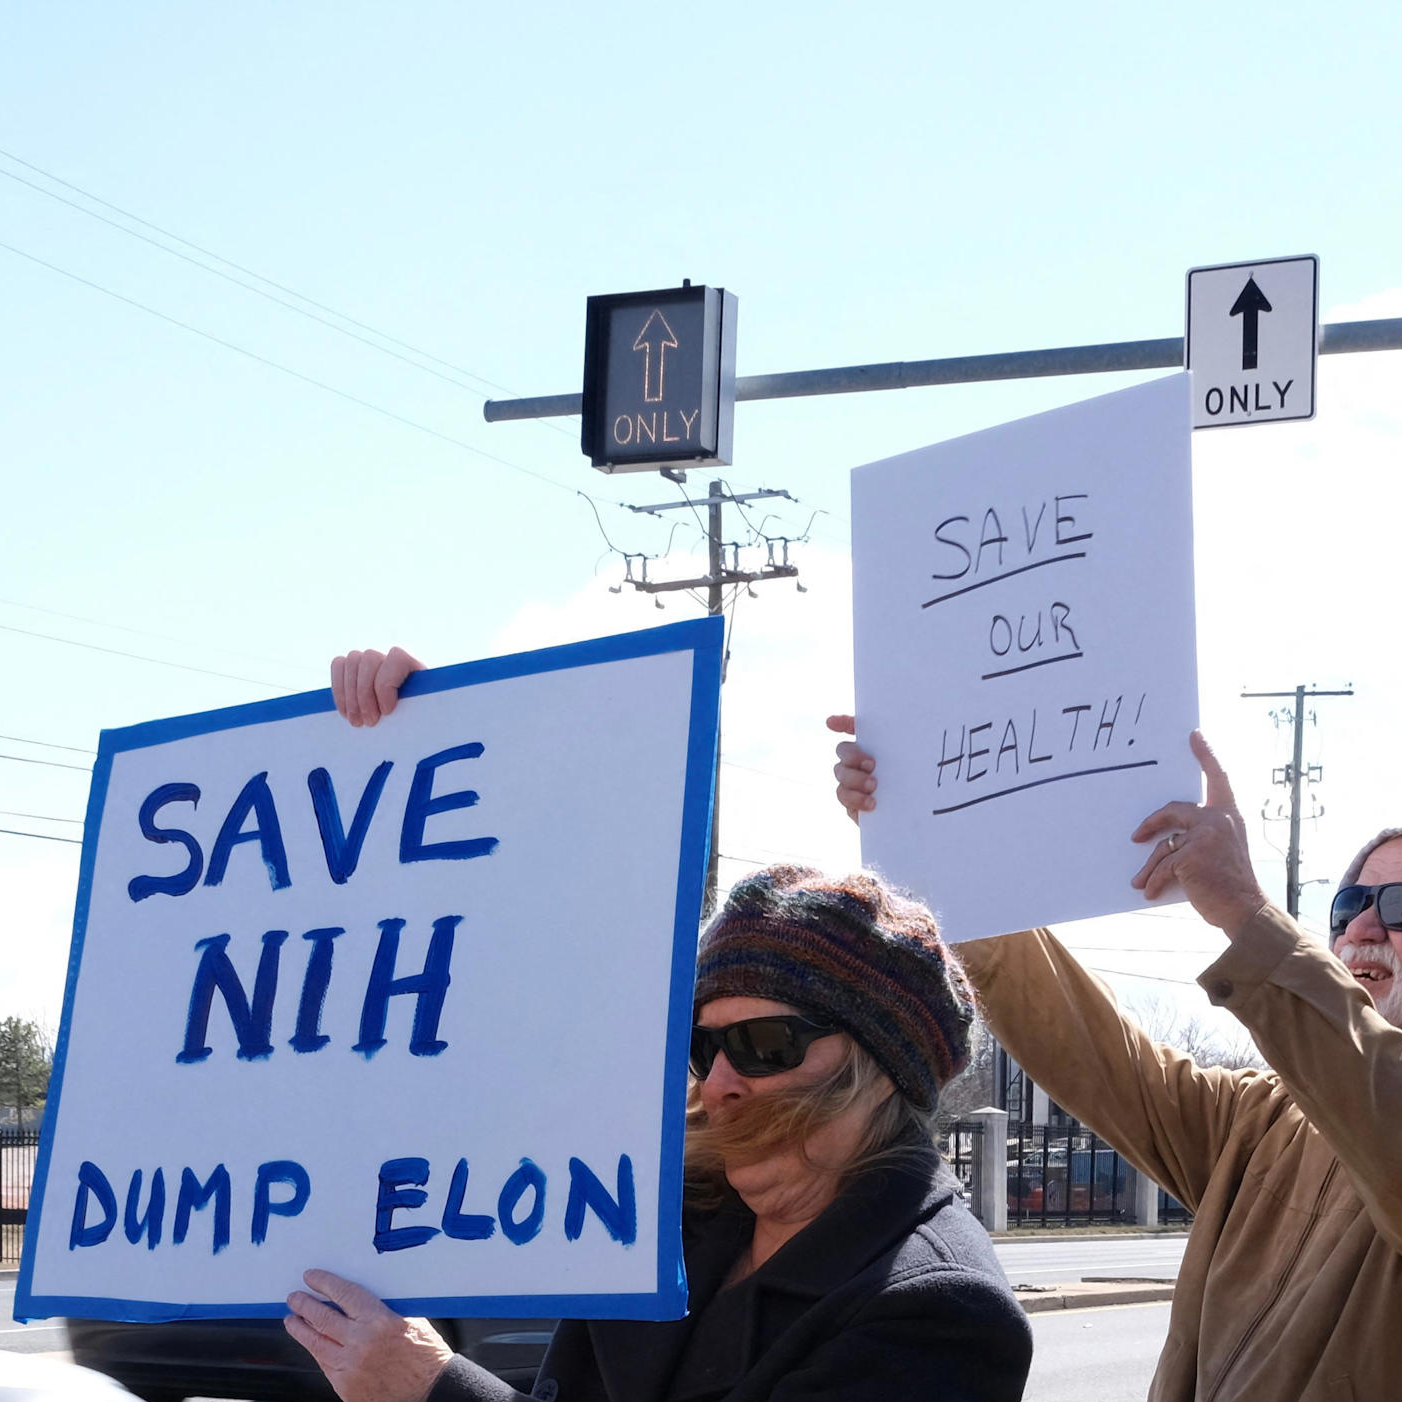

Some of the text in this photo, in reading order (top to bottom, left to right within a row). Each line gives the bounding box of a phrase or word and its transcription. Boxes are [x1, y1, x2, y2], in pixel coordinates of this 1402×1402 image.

[613, 408, 699, 445] ONLY
[1205, 379, 1294, 416] ONLY
[932, 494, 1094, 580] SAVE
[989, 601, 1081, 656] OUR
[936, 693, 1147, 788] HEALTH!
[127, 741, 500, 904] SAVE
[175, 914, 465, 1064] NIH
[69, 1153, 637, 1255] DUMP ELON
